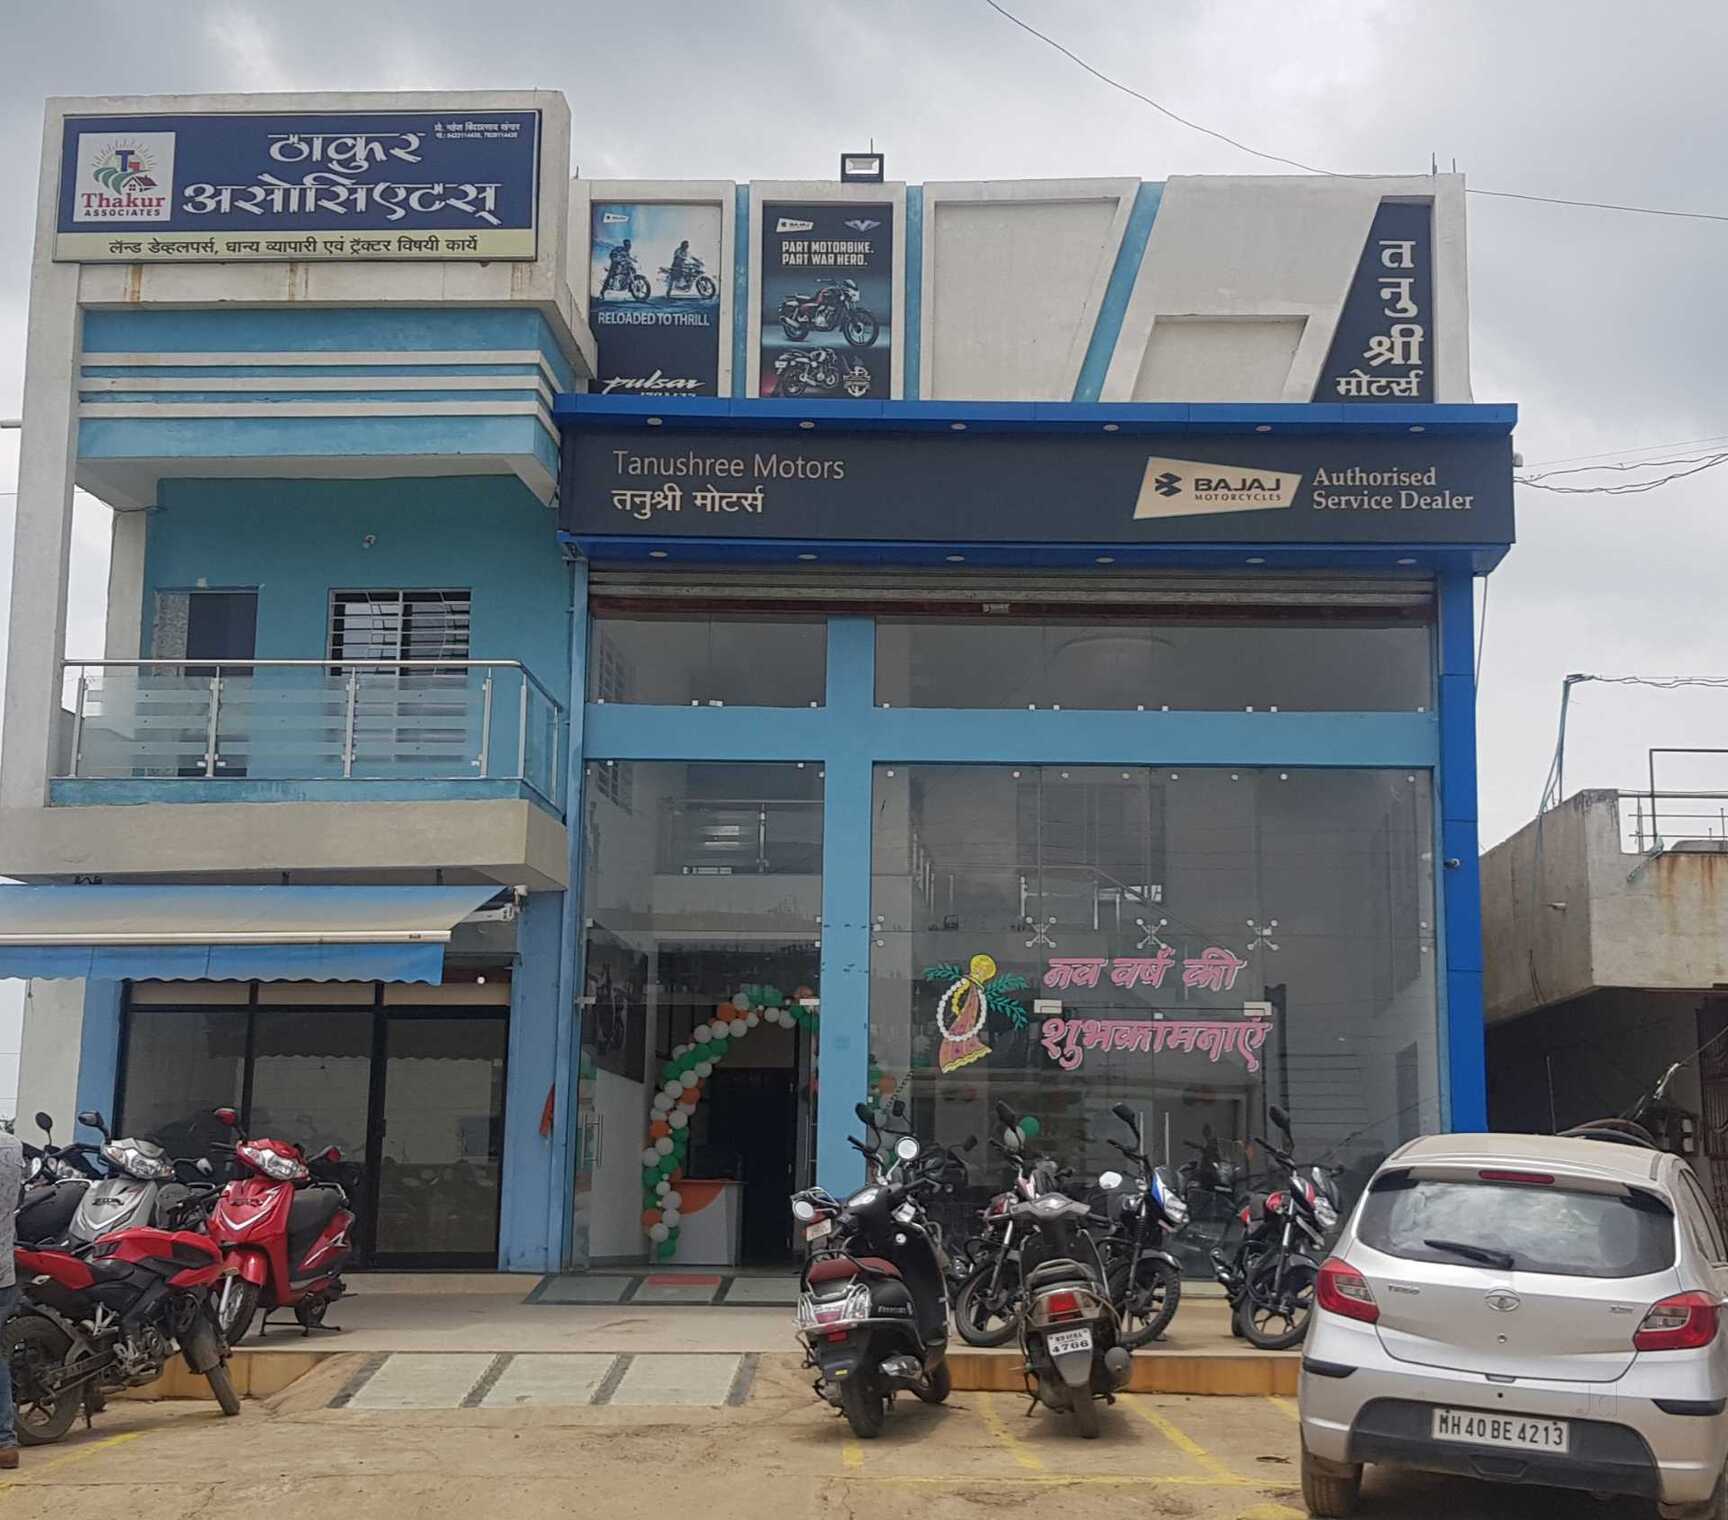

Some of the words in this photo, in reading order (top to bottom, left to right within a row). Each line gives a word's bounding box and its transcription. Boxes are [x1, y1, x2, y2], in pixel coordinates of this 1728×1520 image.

[268, 132, 426, 174] ठाकुर
[81, 192, 166, 208] Thakur
[84, 208, 160, 217] ASSOCIATES
[225, 240, 260, 253] धान्य
[265, 236, 317, 253] व्यापारी
[323, 235, 345, 255] एवं
[397, 235, 440, 252] विषयी
[782, 241, 809, 253] PART
[811, 241, 874, 254] MOTORBIKE.
[782, 253, 809, 265] PART
[811, 253, 835, 265] WAR
[837, 253, 868, 266] HERO.
[598, 311, 656, 325] RELOADED
[658, 313, 672, 326] TO
[672, 313, 710, 326] THRILL
[601, 369, 706, 395] pulsar
[1335, 368, 1424, 396] मोटर्स
[613, 450, 745, 477] Tanushree
[753, 453, 845, 479] Motors
[1194, 478, 1281, 492] BAJAJ
[1312, 466, 1437, 486] Authorised
[610, 482, 684, 520] तनुश्री
[692, 483, 765, 513] मोटर्स
[1194, 493, 1281, 502] MOTORCYCLES
[1313, 490, 1393, 510] Service
[1400, 490, 1474, 510] Dealer
[1043, 957, 1108, 990] नव
[1440, 1414, 1461, 1435] MH
[1465, 1417, 1486, 1437] 40
[1491, 1420, 1512, 1441] BE
[1518, 1423, 1563, 1446] 4213
